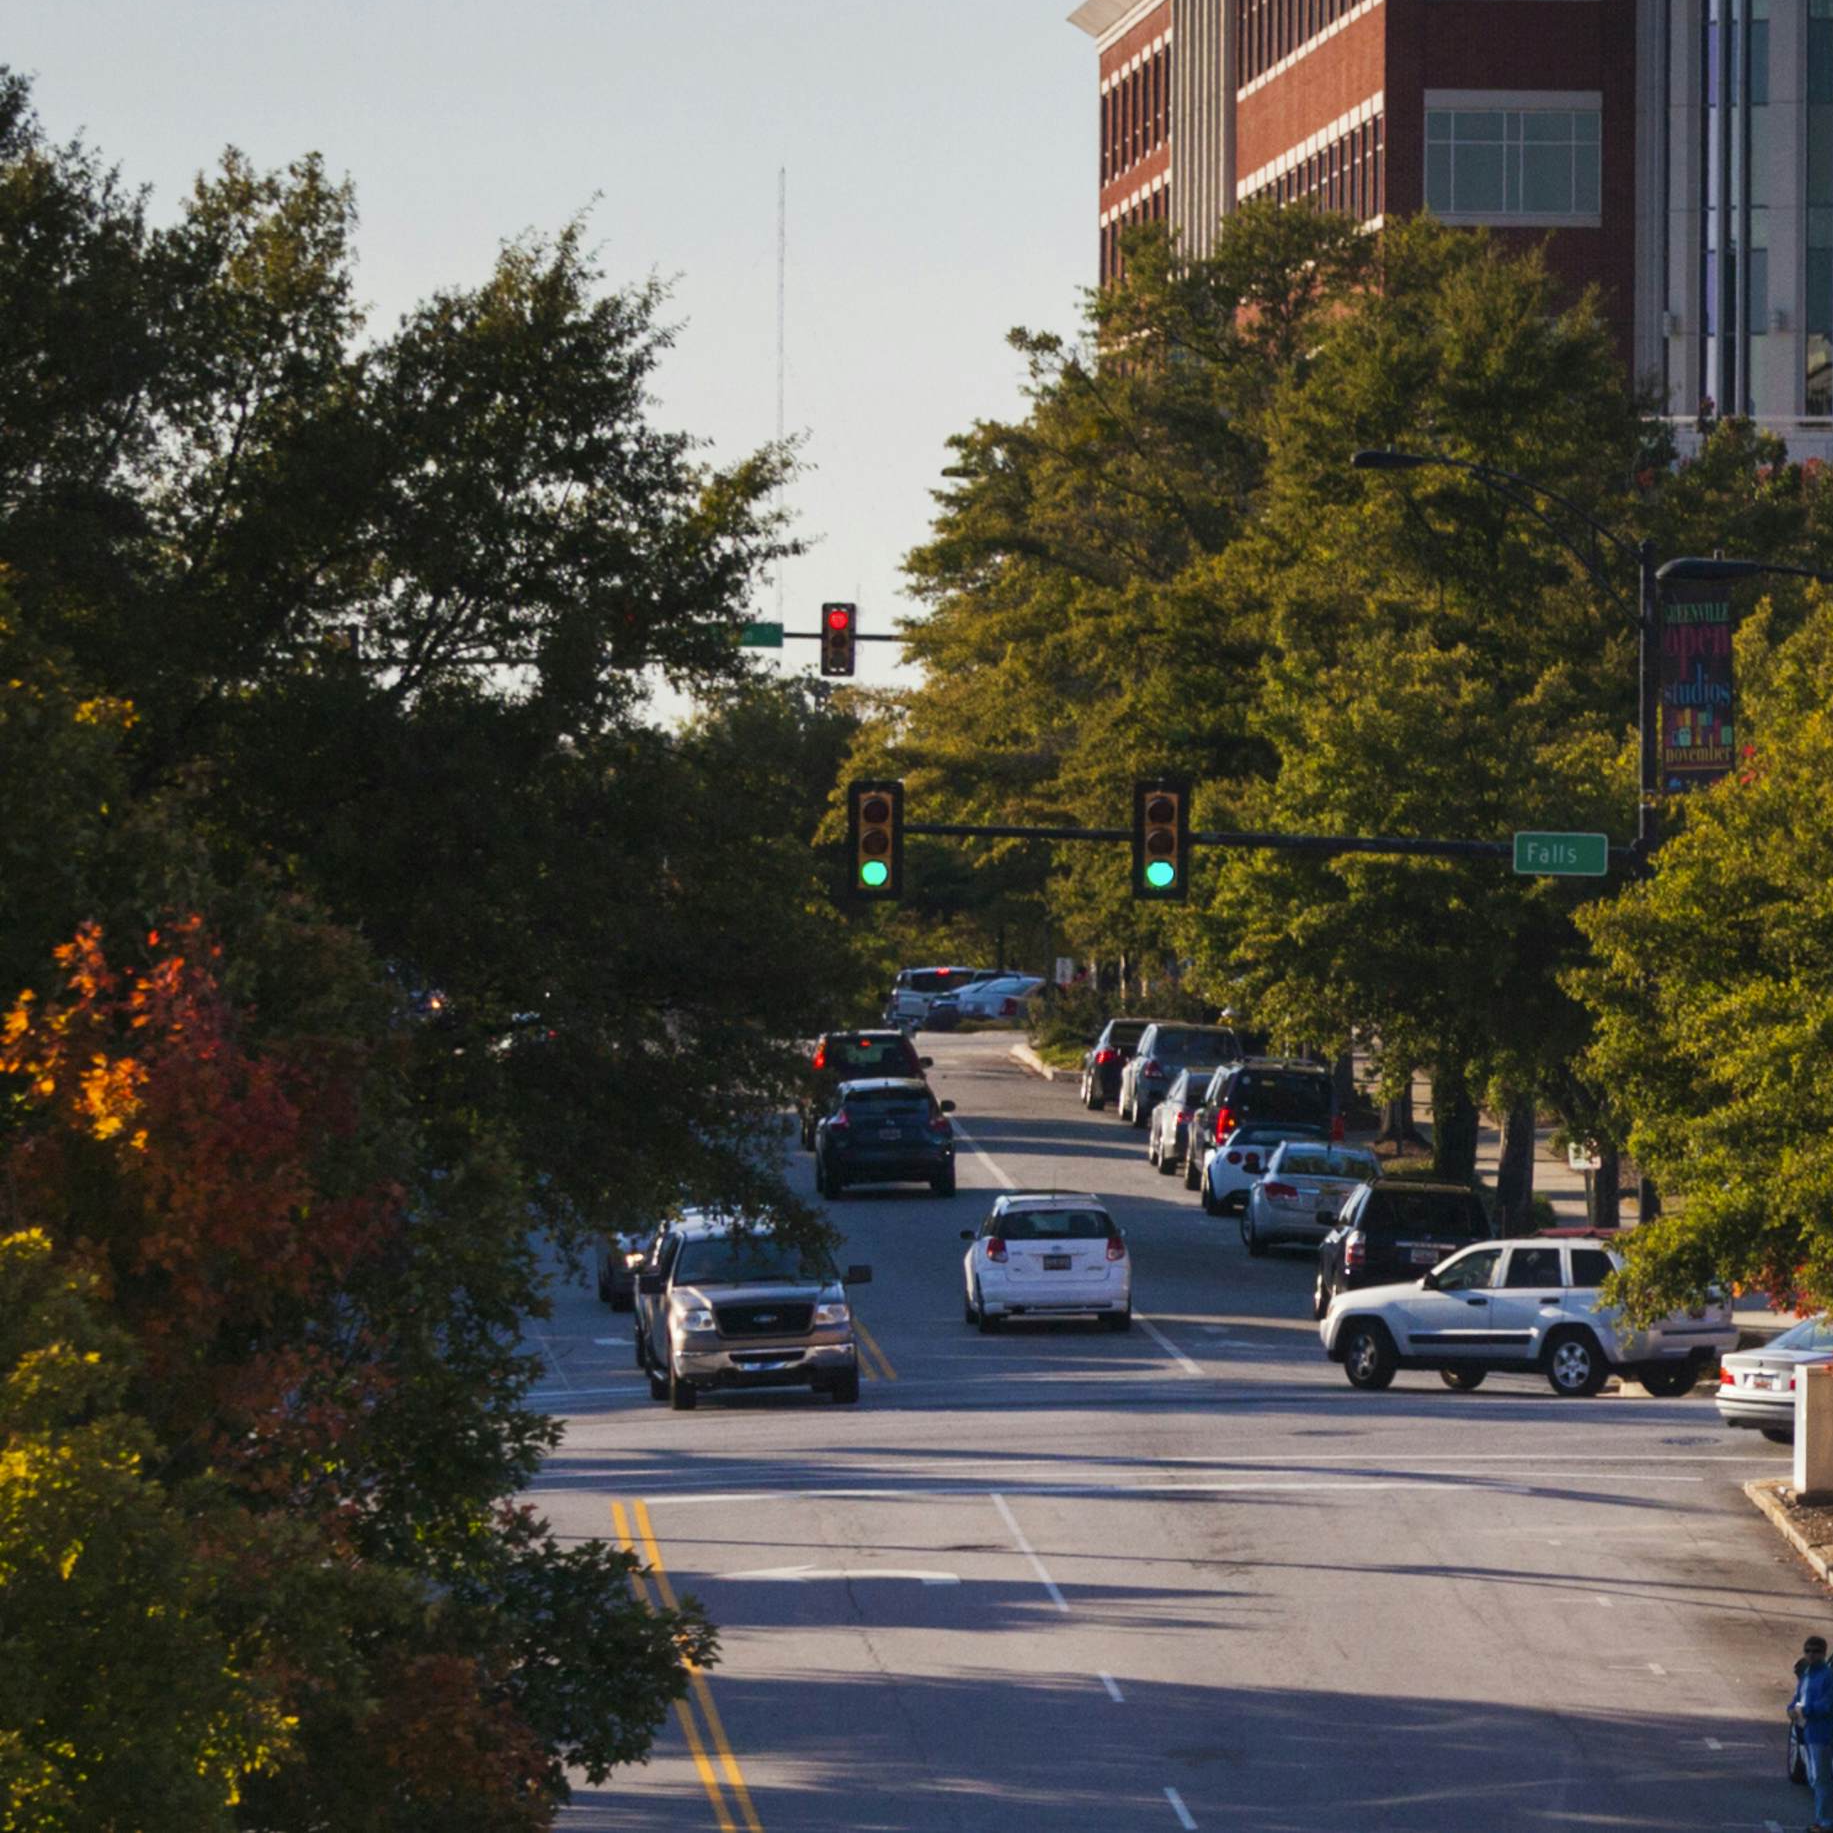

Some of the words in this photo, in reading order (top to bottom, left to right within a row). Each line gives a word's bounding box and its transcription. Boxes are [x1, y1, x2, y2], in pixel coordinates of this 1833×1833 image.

[1664, 662, 1731, 707] studios
[1665, 734, 1730, 764] november
[1527, 842, 1578, 864] Falls
